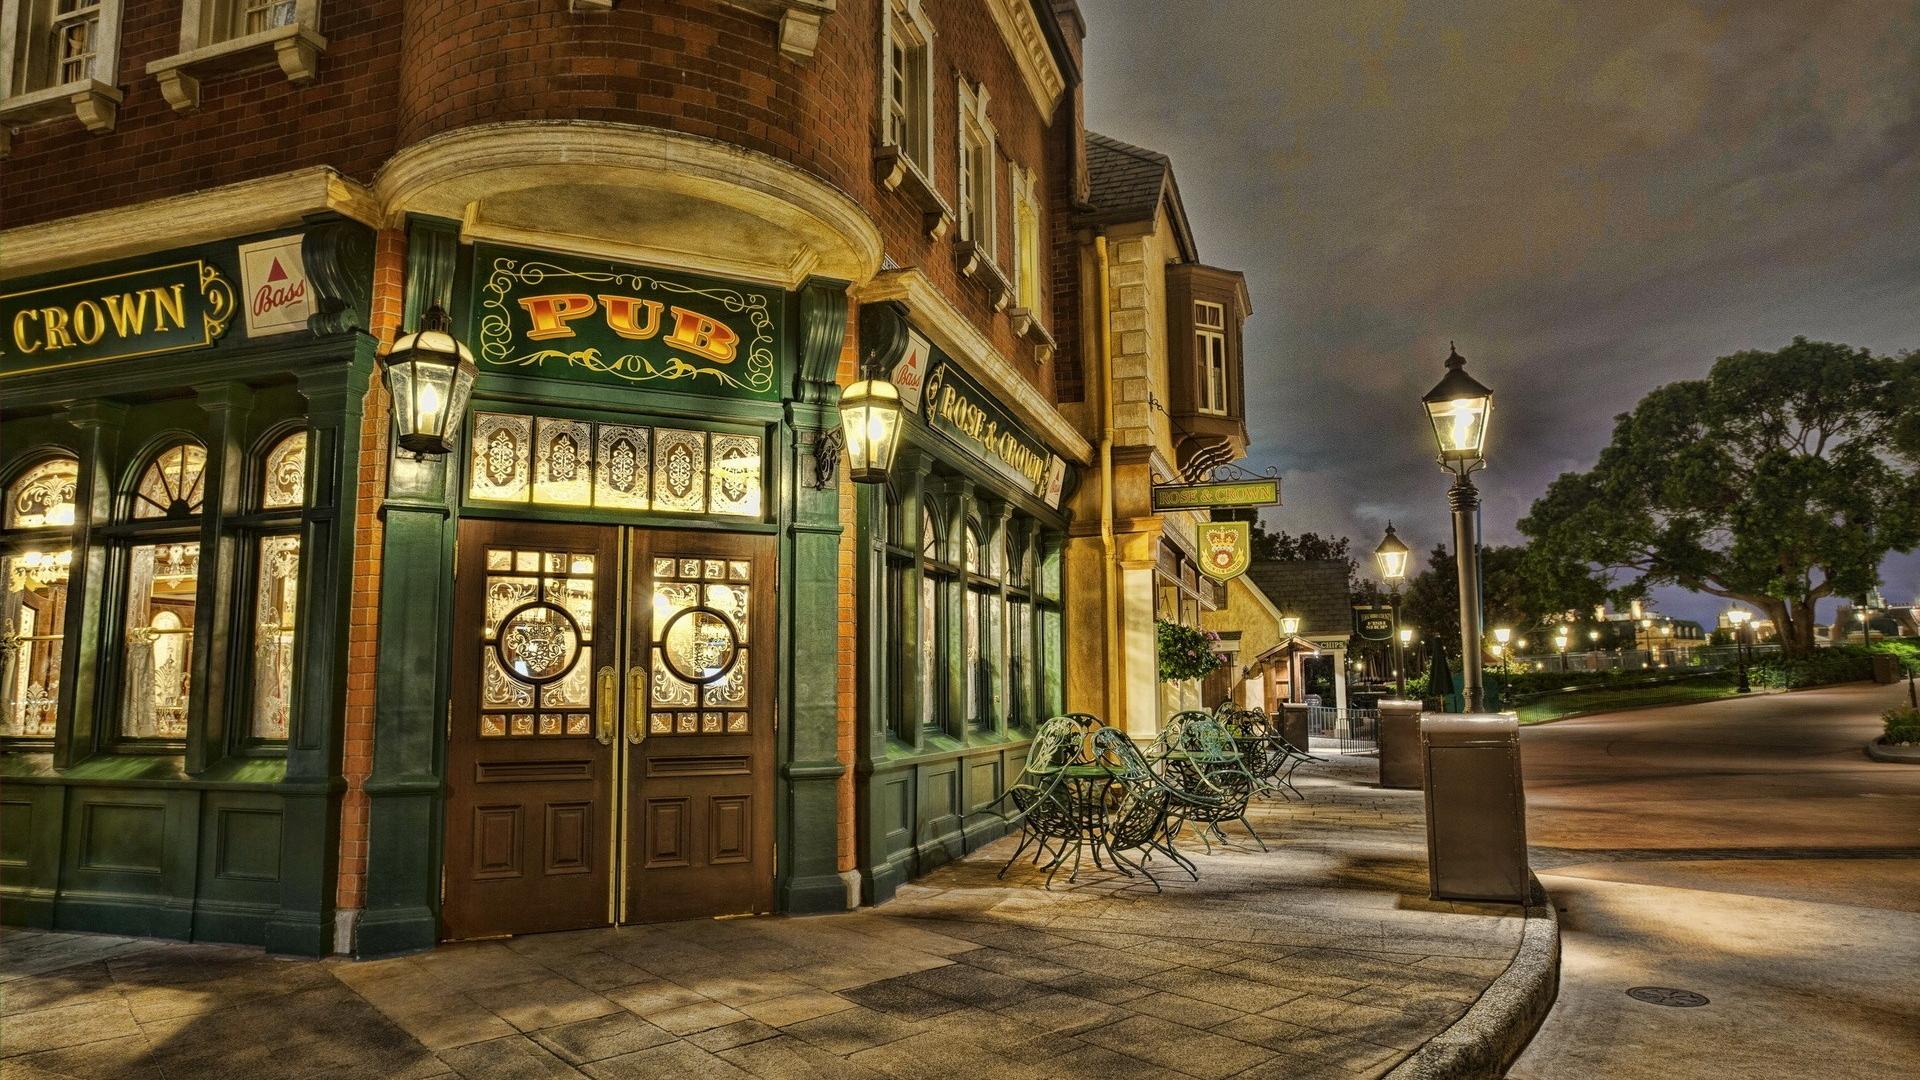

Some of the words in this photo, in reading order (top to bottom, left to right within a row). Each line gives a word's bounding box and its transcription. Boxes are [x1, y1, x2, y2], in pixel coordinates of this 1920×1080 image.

[253, 279, 305, 317] Bass
[13, 283, 185, 353] CROWN
[518, 294, 740, 364] PUB
[896, 365, 921, 388] Bass
[940, 383, 987, 442] ROSE
[984, 421, 998, 453] &
[998, 431, 1044, 484] CROWN
[1159, 490, 1199, 505] ROSE
[1200, 489, 1213, 503] &
[1214, 486, 1272, 503] CROWN
[1320, 641, 1344, 649] CHIPS
